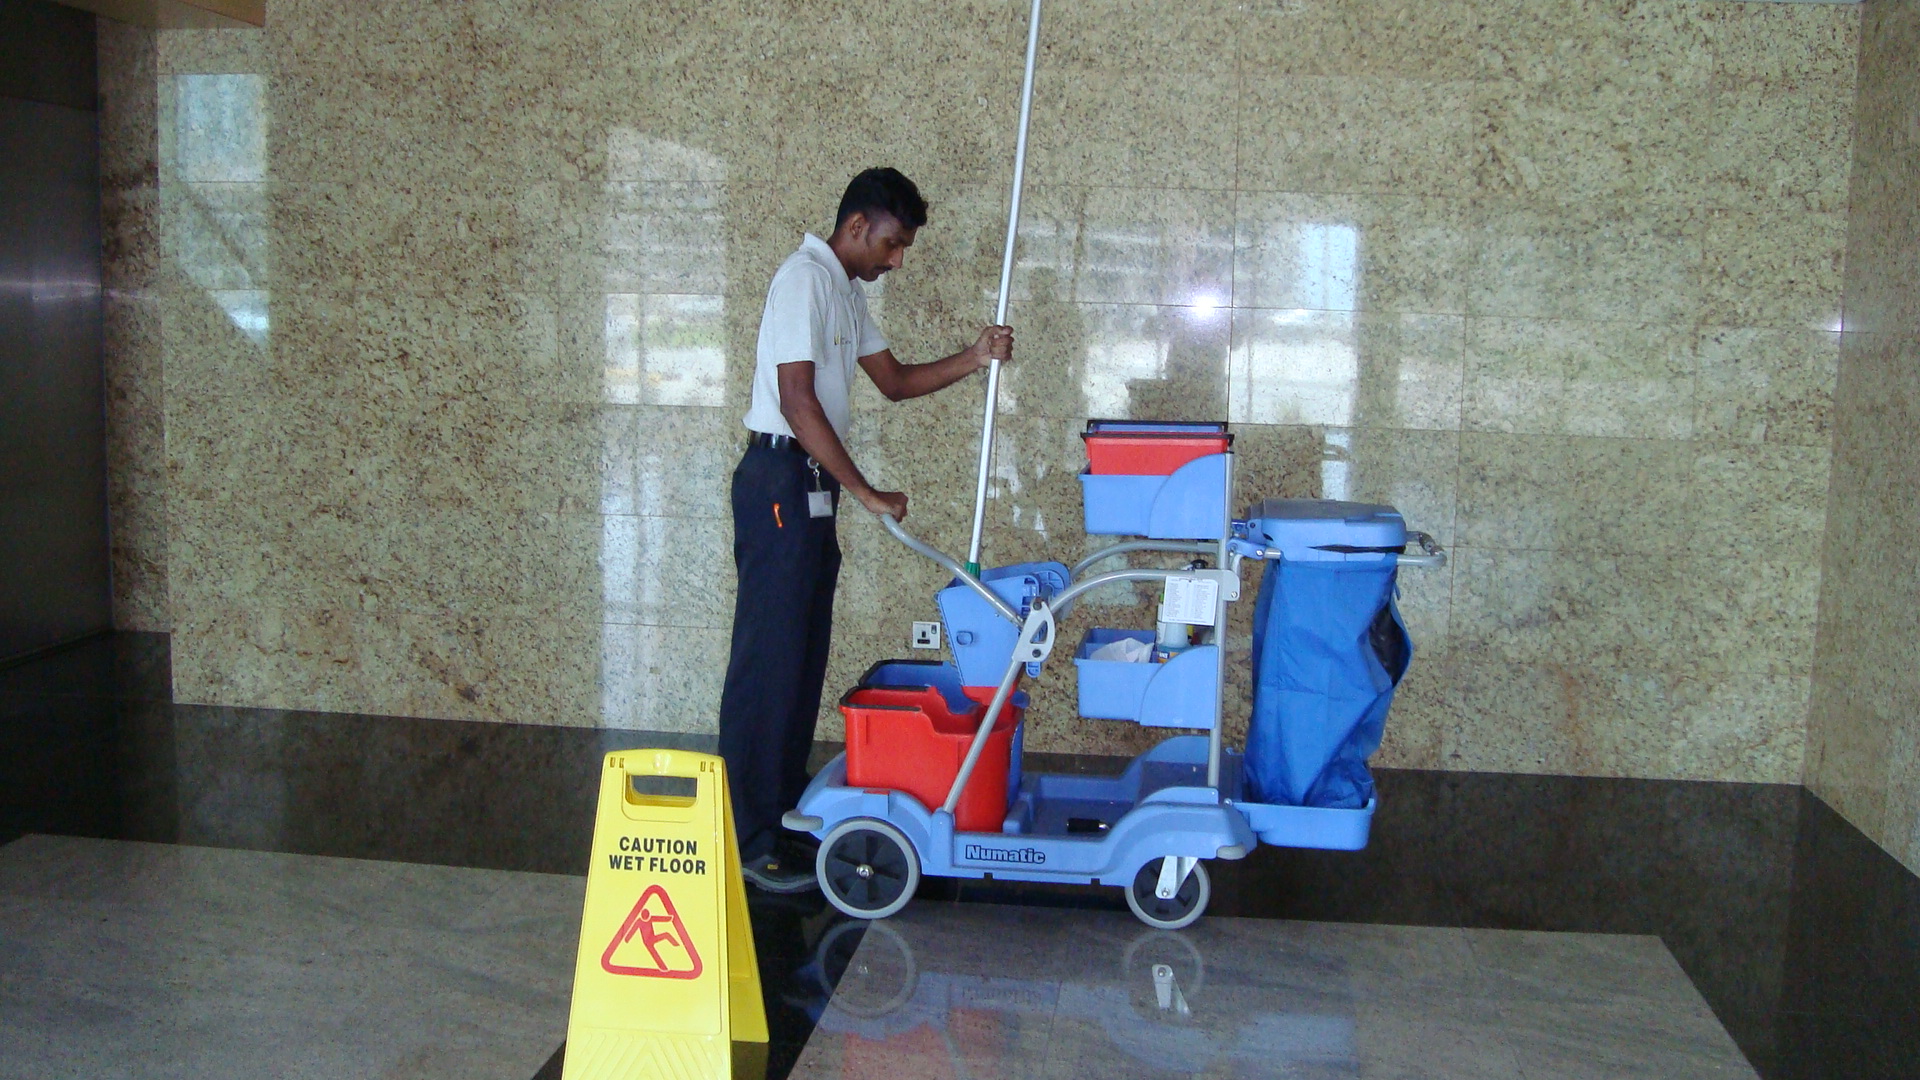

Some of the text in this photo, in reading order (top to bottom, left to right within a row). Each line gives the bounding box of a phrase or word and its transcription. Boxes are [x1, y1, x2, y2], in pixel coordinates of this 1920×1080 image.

[619, 836, 697, 856] CAUTION
[965, 844, 1046, 865] Numatic
[609, 854, 706, 875] WET FLOOR
